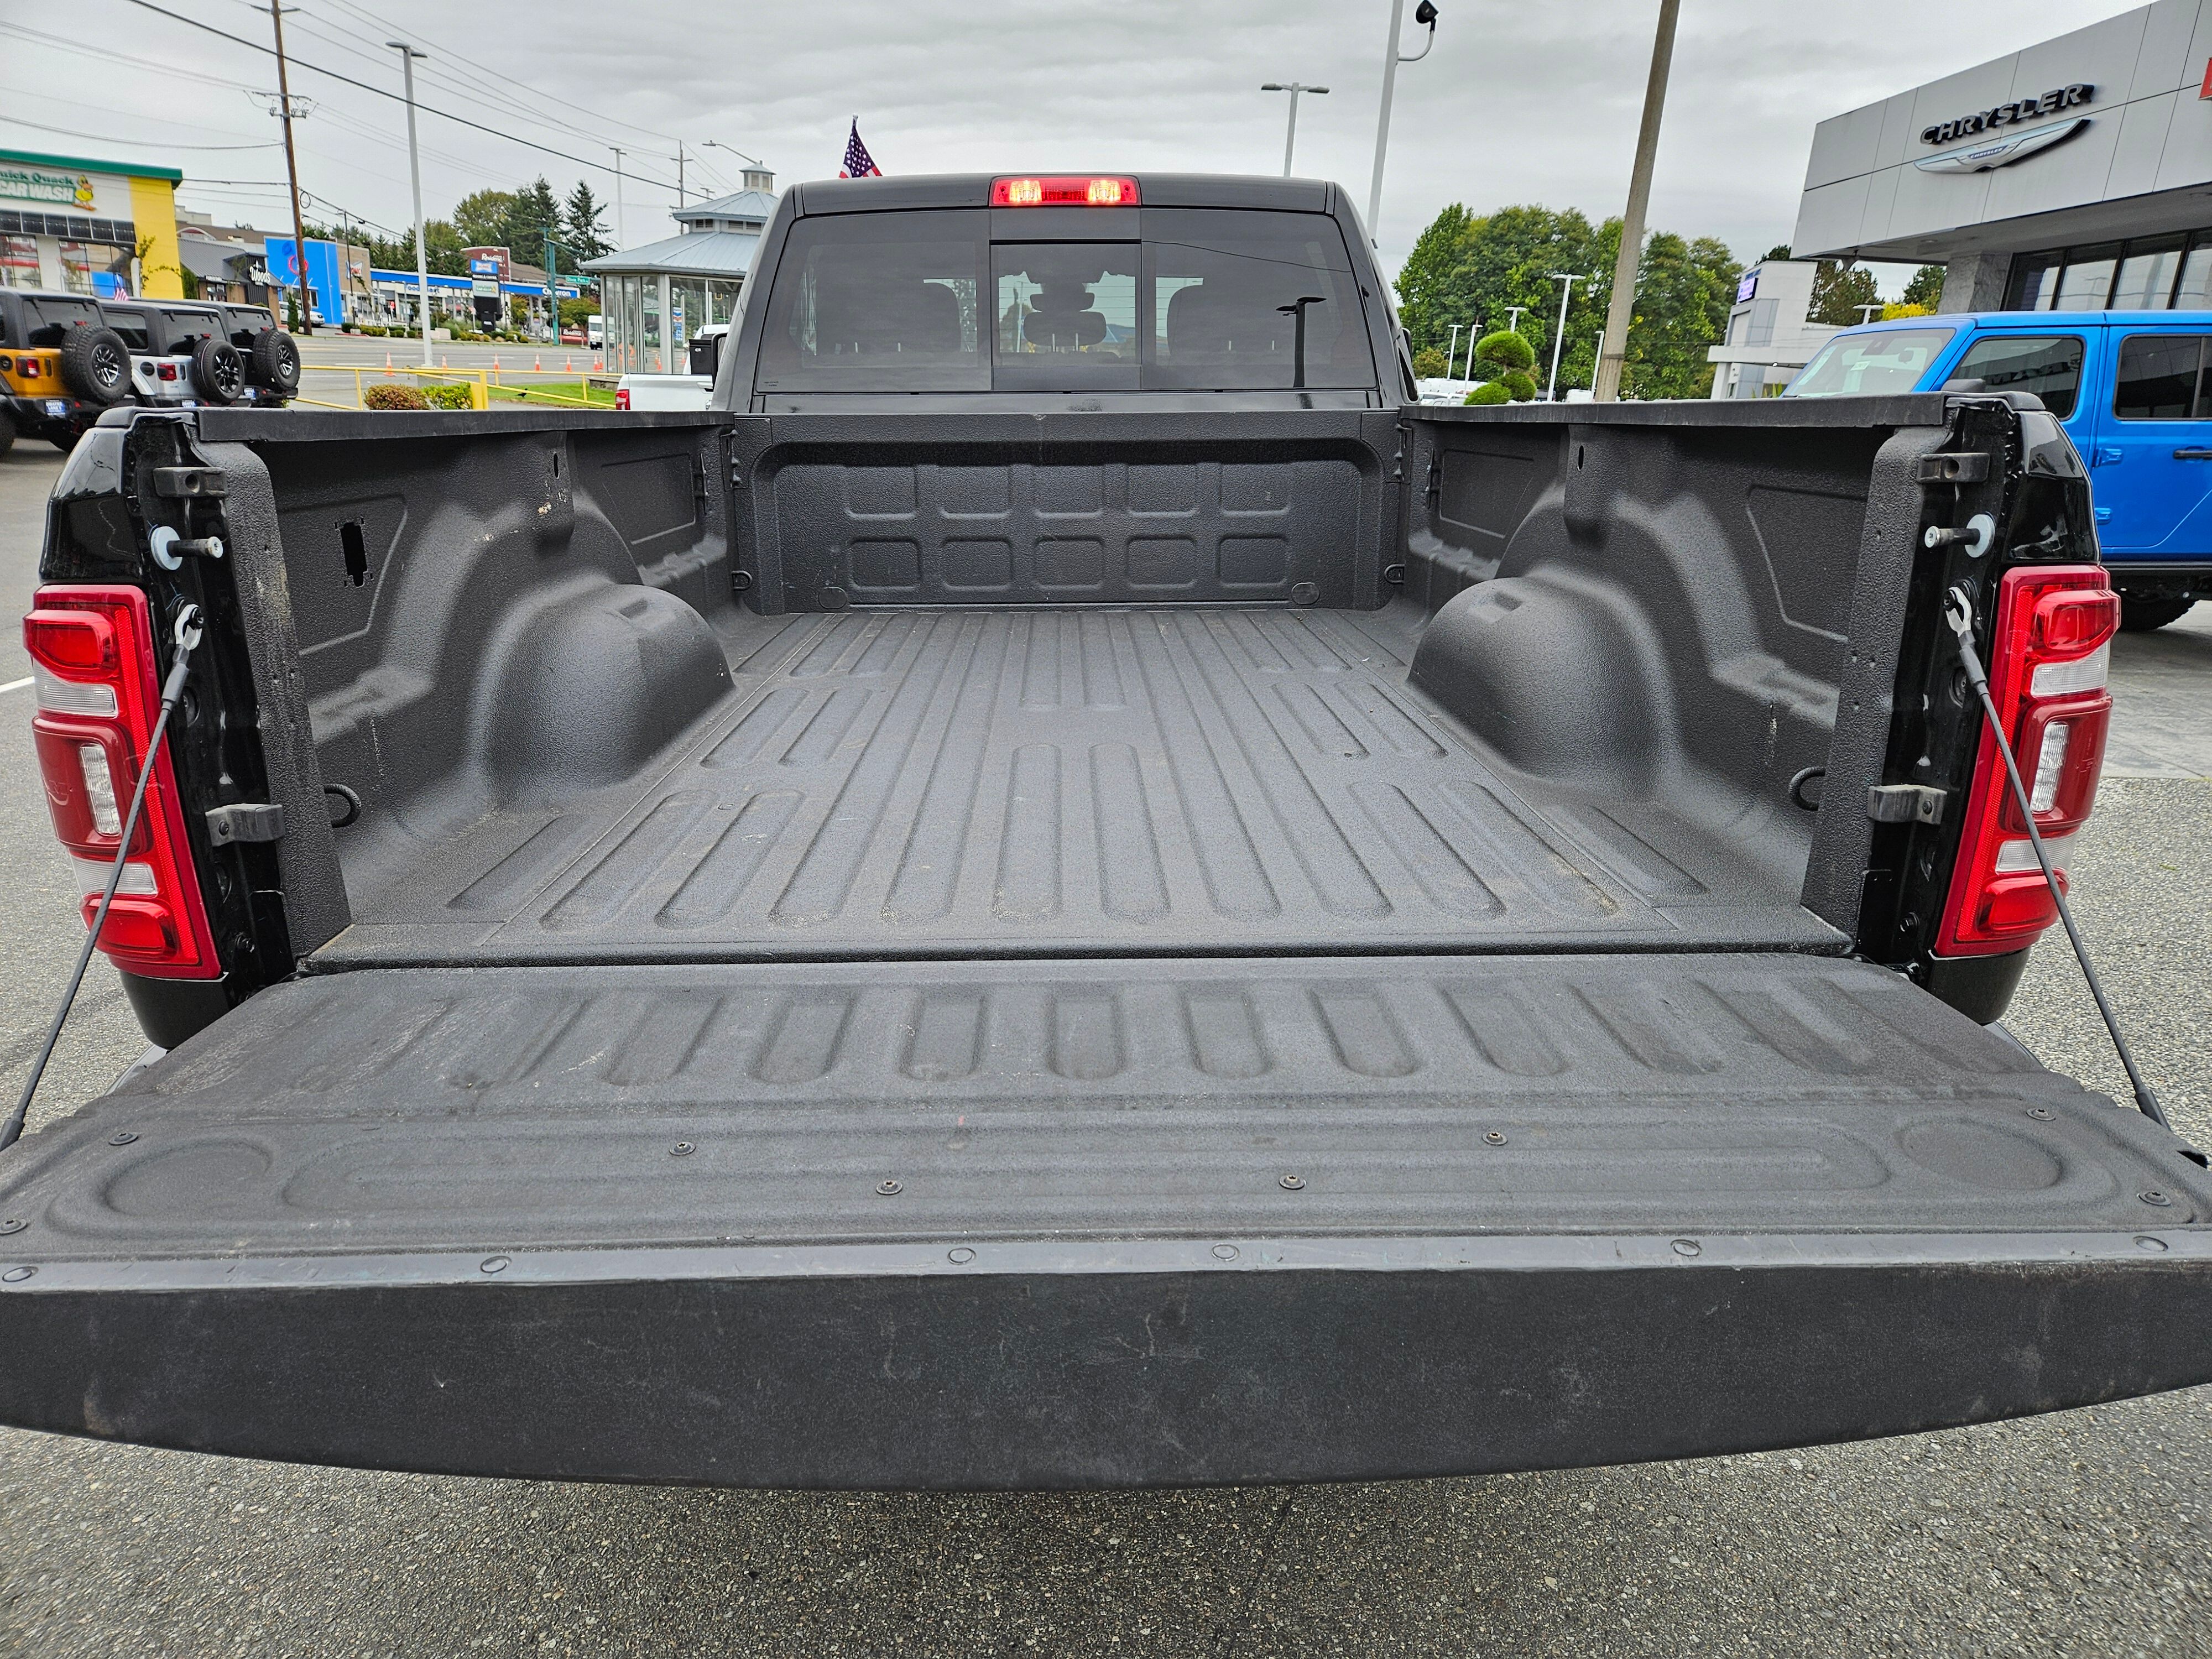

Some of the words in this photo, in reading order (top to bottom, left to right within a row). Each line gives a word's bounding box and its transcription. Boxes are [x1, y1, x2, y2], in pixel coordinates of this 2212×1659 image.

[1920, 84, 2086, 145] CHRYSLER
[1970, 148, 2003, 159] CHRYSLER
[0, 170, 29, 180] uick
[32, 173, 74, 185] Quack
[29, 183, 74, 202] WASH
[249, 265, 270, 283] Woods
